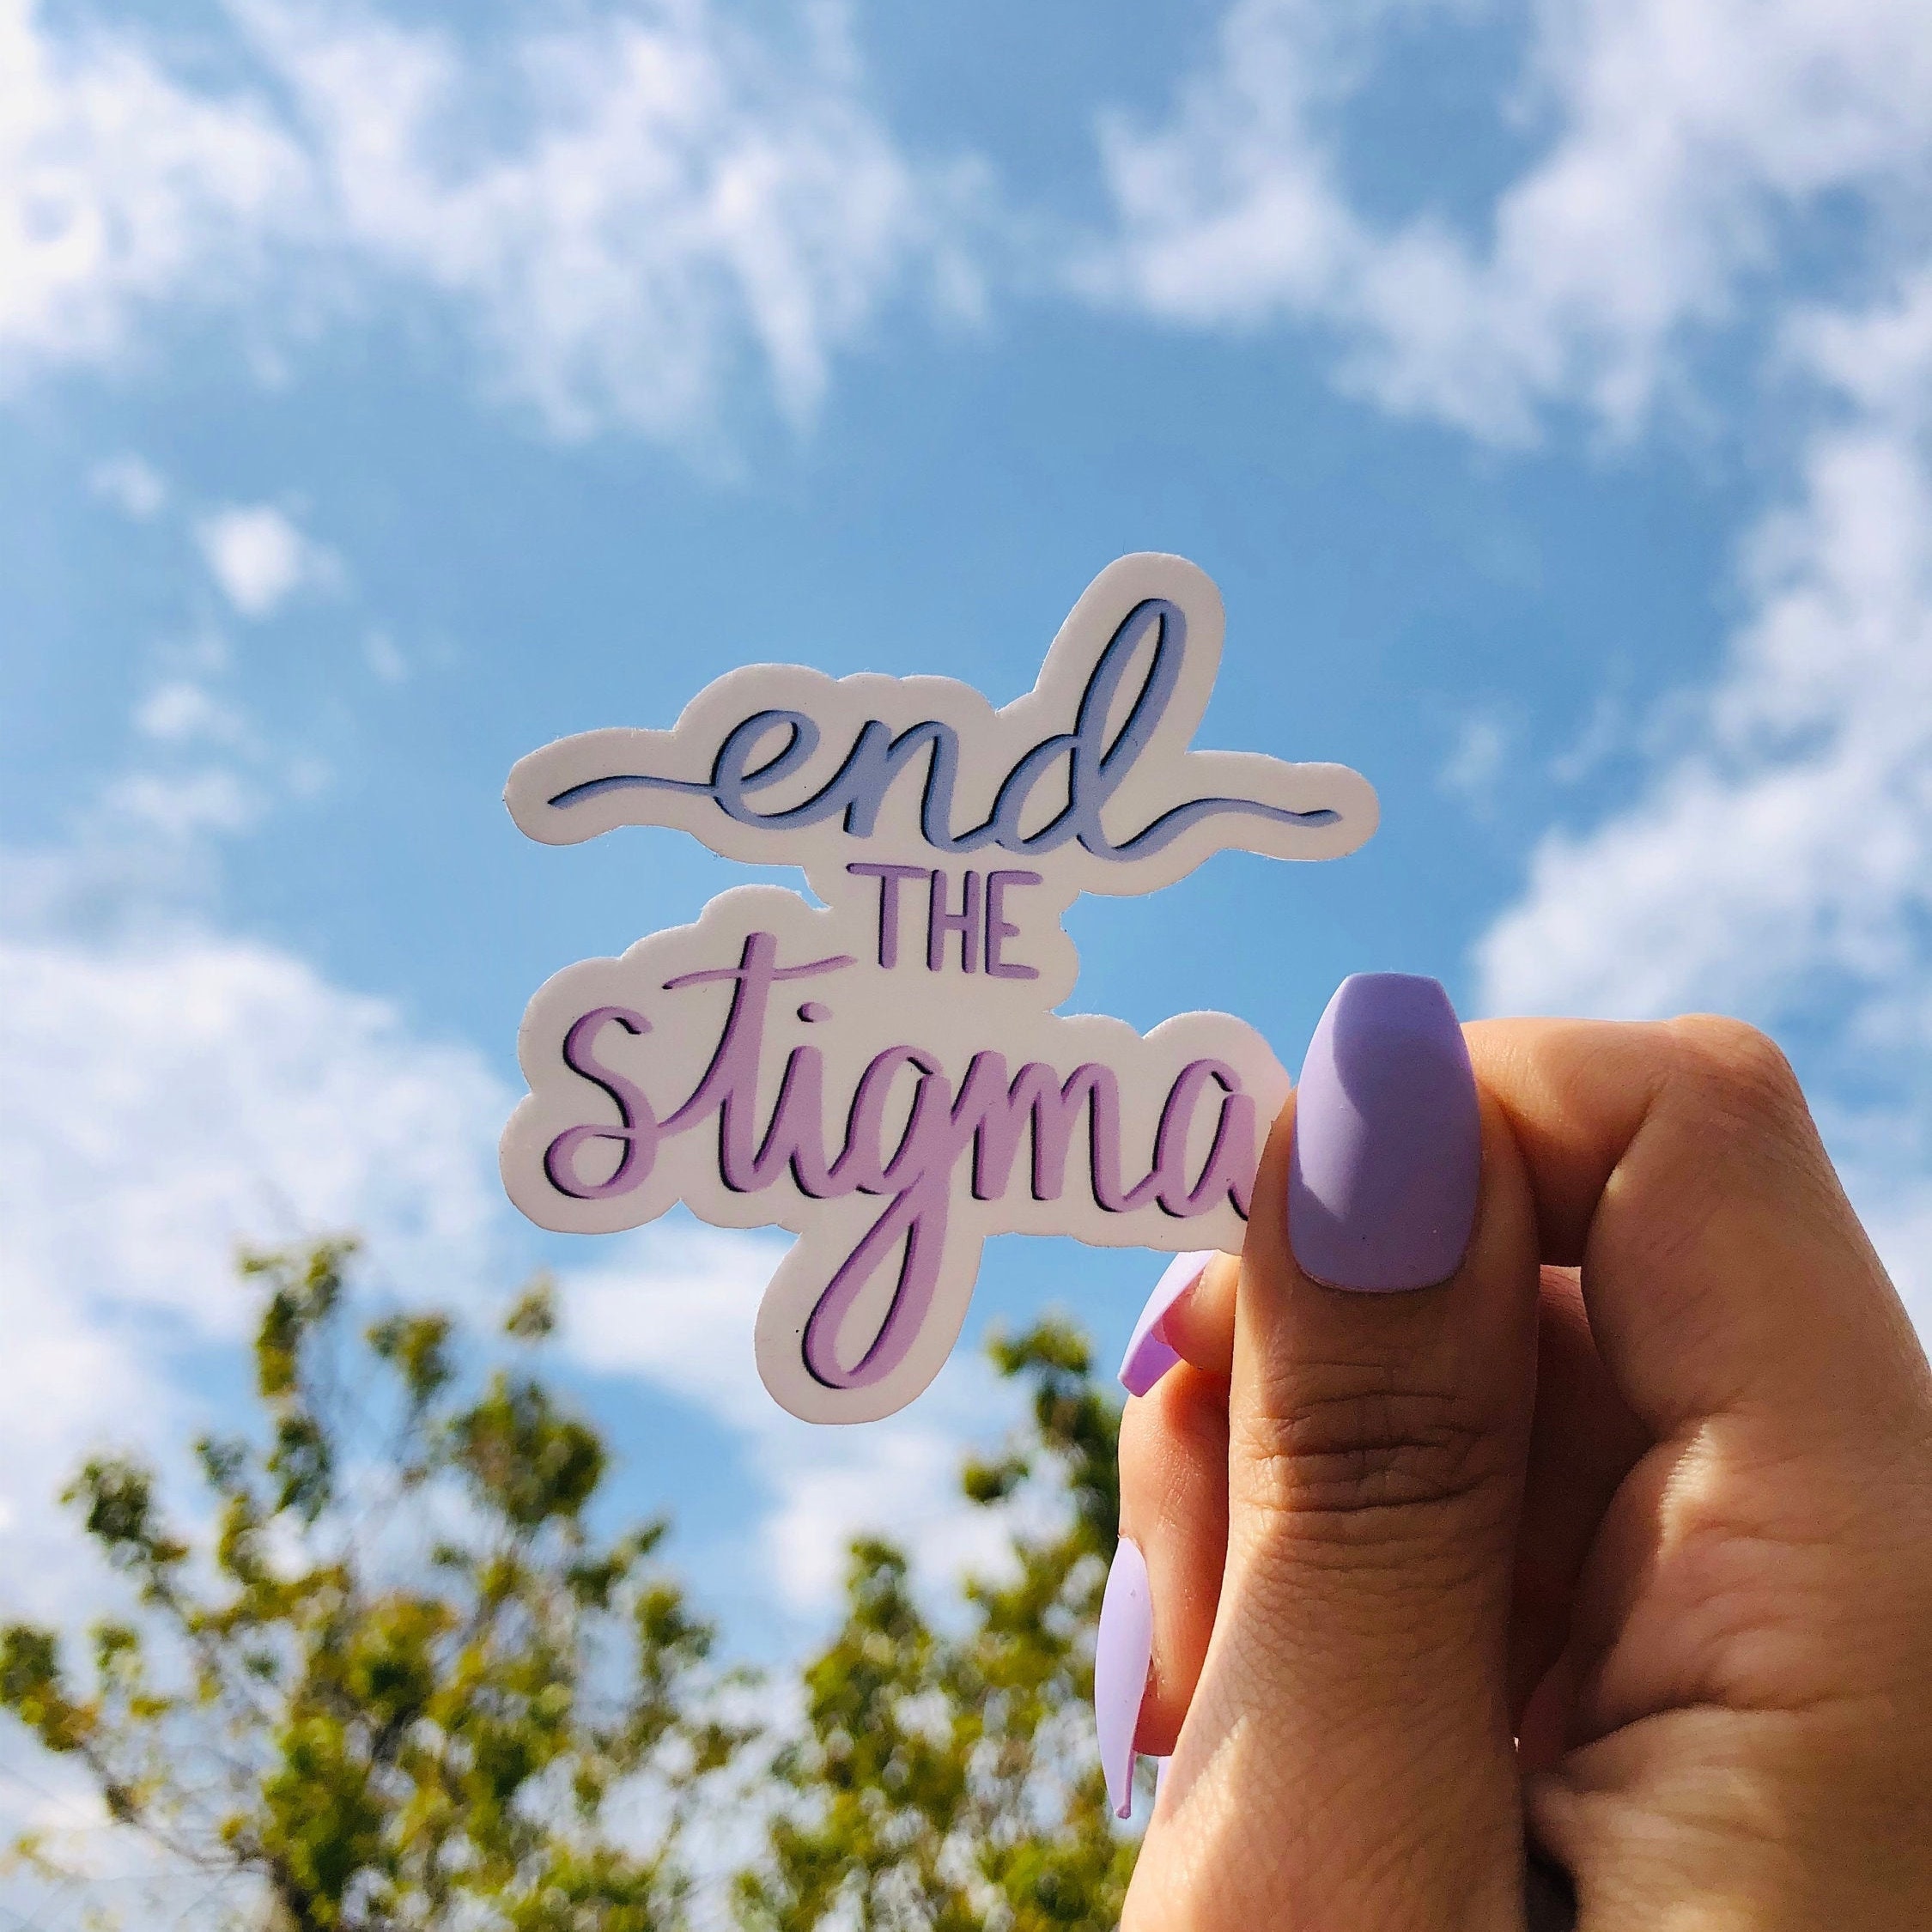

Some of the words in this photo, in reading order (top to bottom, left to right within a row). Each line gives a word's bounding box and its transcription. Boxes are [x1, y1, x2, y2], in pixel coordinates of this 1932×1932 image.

[549, 598, 1341, 858] end
[847, 862, 1042, 979] THE
[544, 933, 1256, 1389] stigma
